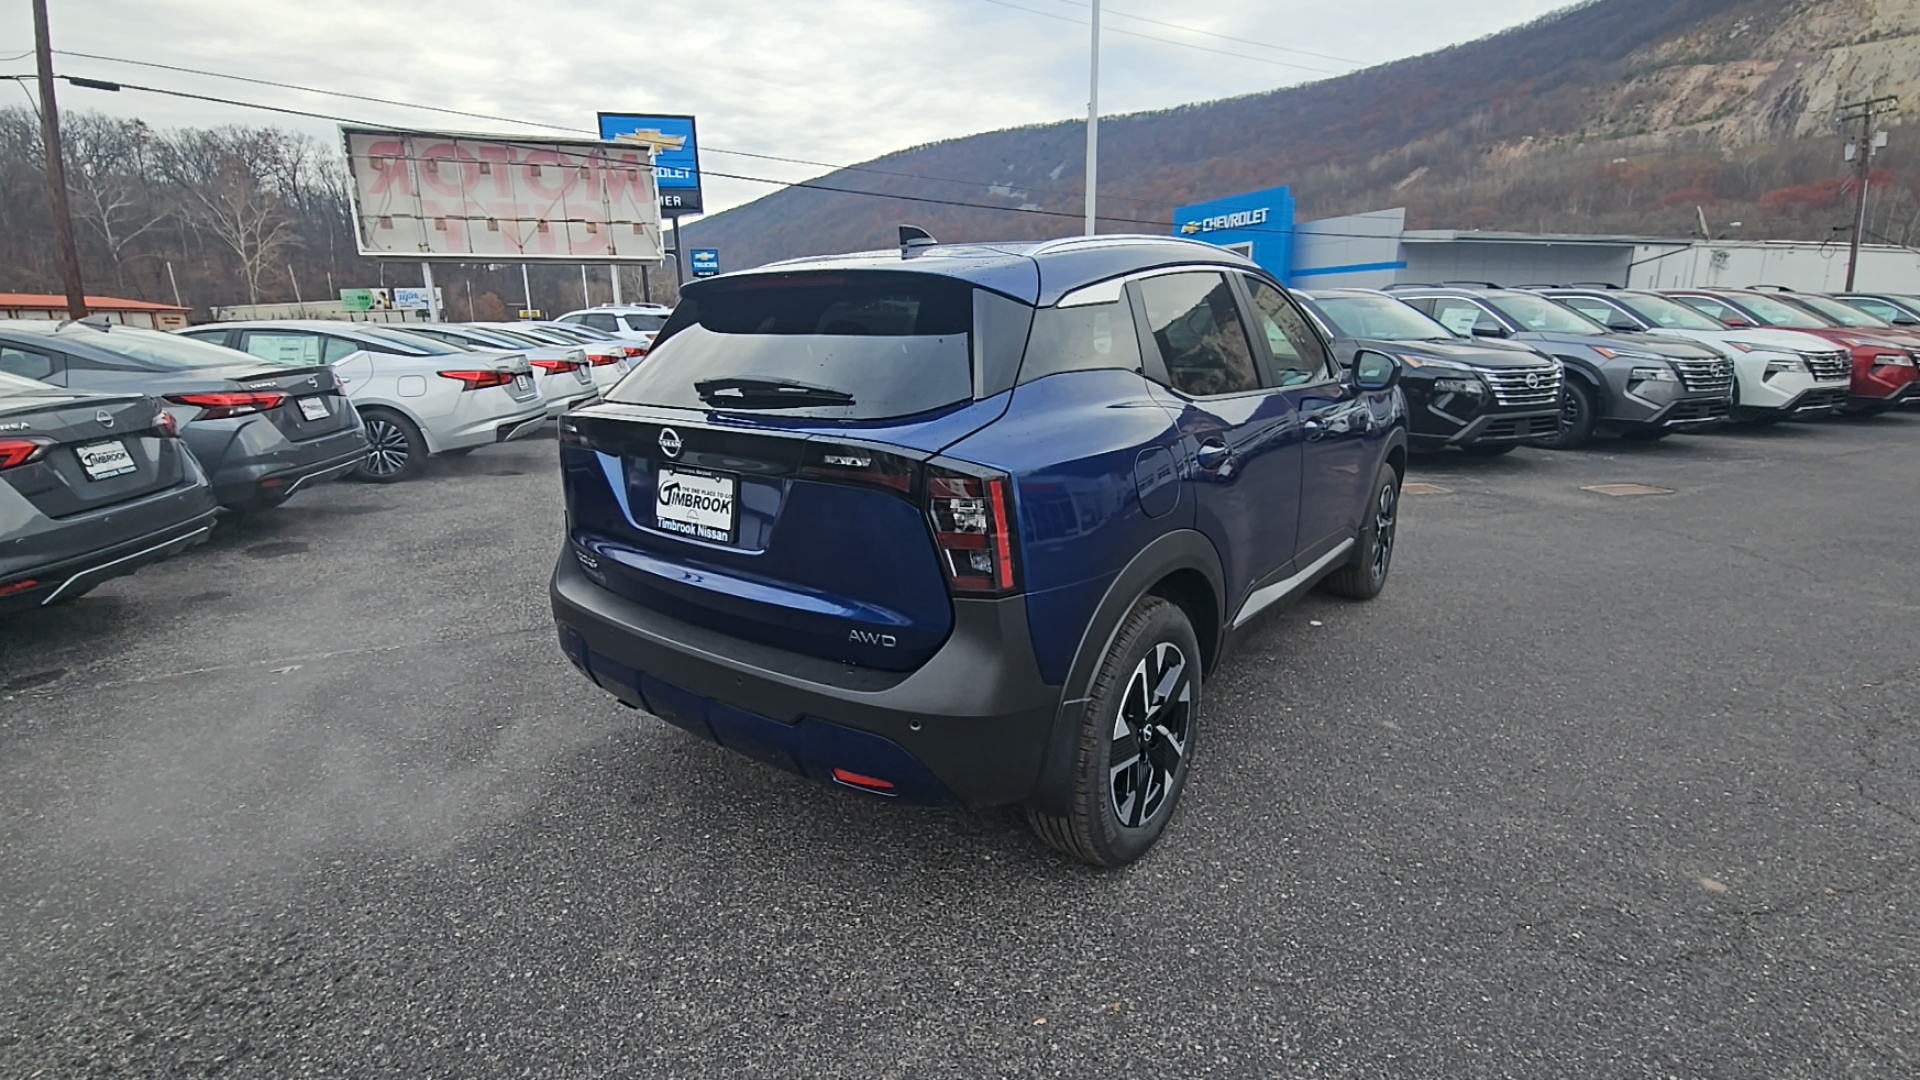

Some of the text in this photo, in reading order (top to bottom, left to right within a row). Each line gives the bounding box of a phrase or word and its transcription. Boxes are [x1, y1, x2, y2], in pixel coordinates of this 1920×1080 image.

[1202, 207, 1270, 232] CHEVROLET
[82, 453, 127, 467] TIMBROOK
[659, 480, 732, 515] TIMBROOK
[691, 487, 700, 495] ONE
[702, 489, 716, 497] PLACE
[657, 516, 728, 542] Timbrook Nissan
[849, 629, 896, 647] AWD
